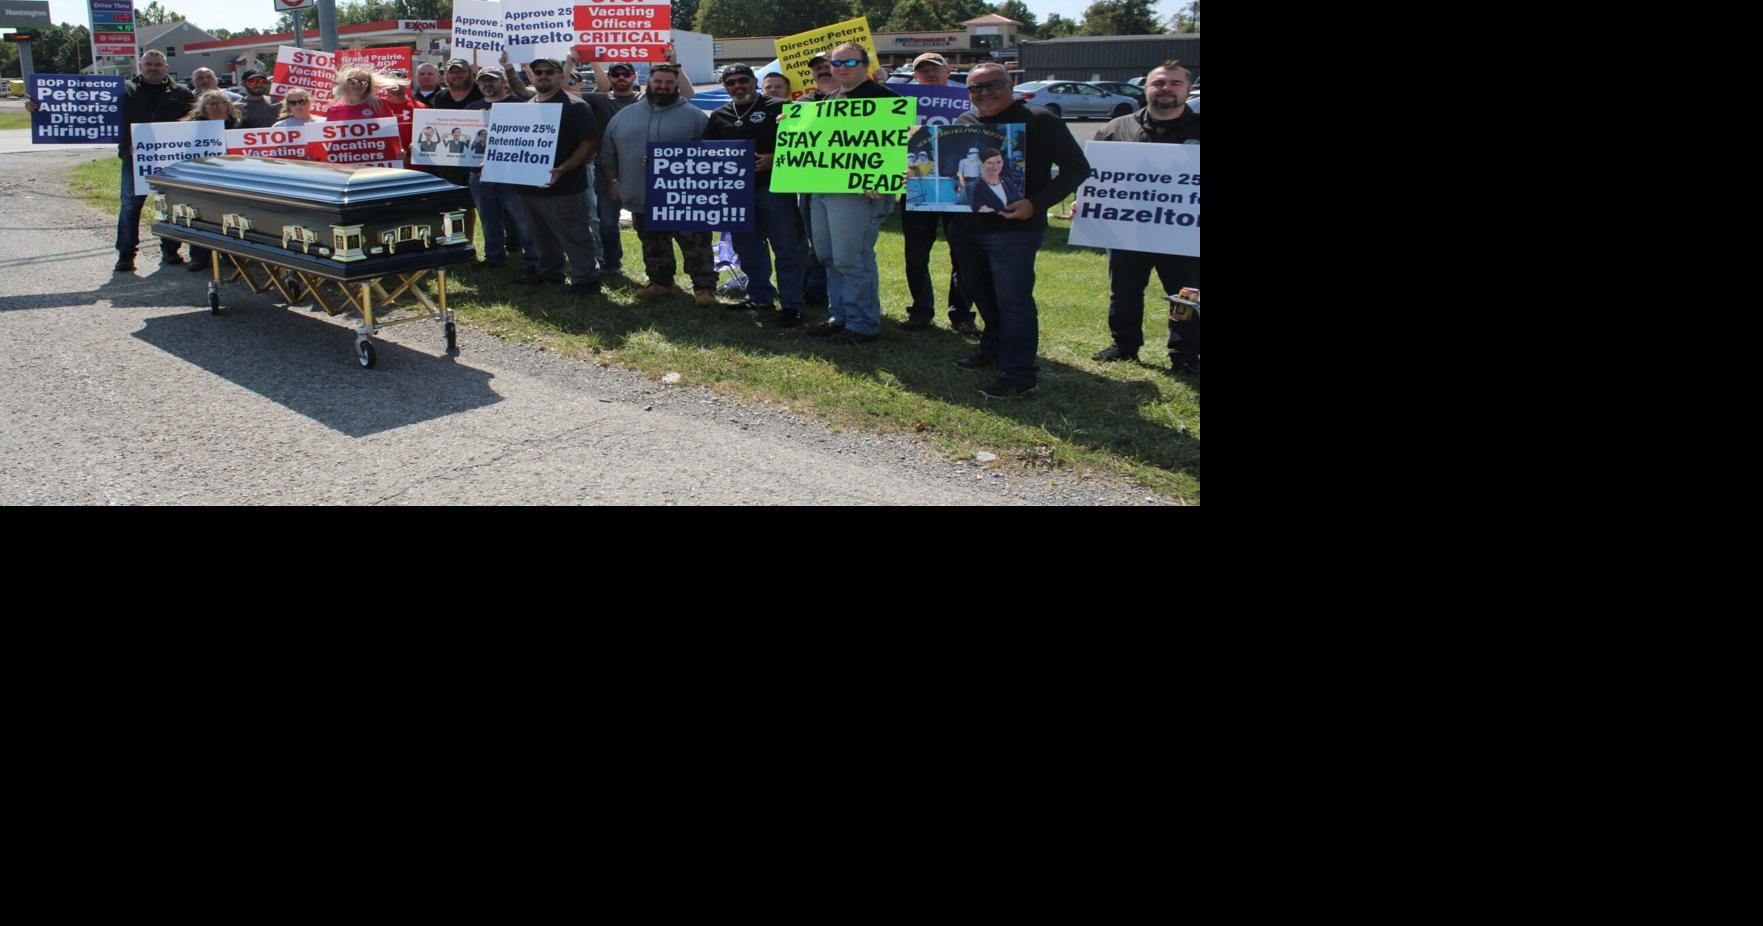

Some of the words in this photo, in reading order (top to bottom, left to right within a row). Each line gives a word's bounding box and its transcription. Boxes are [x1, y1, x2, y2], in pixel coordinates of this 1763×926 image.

[505, 9, 555, 21] Approve
[558, 7, 574, 16] 25
[588, 6, 655, 18] Vacating
[405, 21, 436, 32] EXXON
[455, 15, 498, 27] Approve
[506, 20, 564, 32] Retention
[591, 18, 652, 29] Officers
[454, 27, 504, 39] Retention
[508, 31, 573, 46] Hazelto
[579, 31, 665, 43] CRITICAL
[780, 34, 826, 53] Director
[827, 25, 865, 40] Peters
[594, 45, 648, 58] Posts
[783, 51, 801, 62] and
[803, 42, 833, 56] Grand
[37, 79, 64, 87] BOP
[67, 79, 118, 88] Director
[37, 87, 118, 103] Peters,
[38, 102, 118, 112] Authorize
[790, 104, 802, 118] 2
[816, 99, 876, 118] TIRED
[891, 98, 908, 115] 2
[918, 96, 972, 110] OFFICE
[51, 113, 105, 124] Direct
[38, 125, 119, 139] Hiring!!!
[322, 123, 381, 138] STOP
[490, 123, 530, 134] Approve
[532, 124, 556, 134] 25%
[136, 141, 191, 151] Approve
[194, 138, 223, 148] 25%
[243, 131, 302, 146] STOP
[488, 136, 536, 148] Retention
[537, 137, 553, 148] for
[777, 130, 822, 149] STAY
[828, 128, 909, 148] AWAKE
[242, 146, 305, 158] Vacating
[322, 139, 386, 152] Vacating
[653, 147, 684, 157] BOP
[686, 147, 747, 157] Director
[136, 151, 200, 162] Retention
[204, 150, 223, 158] for
[327, 151, 384, 163] Officers
[487, 149, 550, 165] Hazelton
[775, 150, 885, 170] #WALKING
[653, 158, 746, 177] Peters,
[847, 172, 905, 192] DEAD
[1089, 167, 1172, 184] Approve
[1177, 173, 1200, 186] 25
[653, 177, 746, 190] Authorize
[666, 191, 729, 205] Direct
[1082, 185, 1183, 204] Retention
[652, 206, 746, 226] Hiring!!!
[1080, 202, 1200, 228] Hazelto
